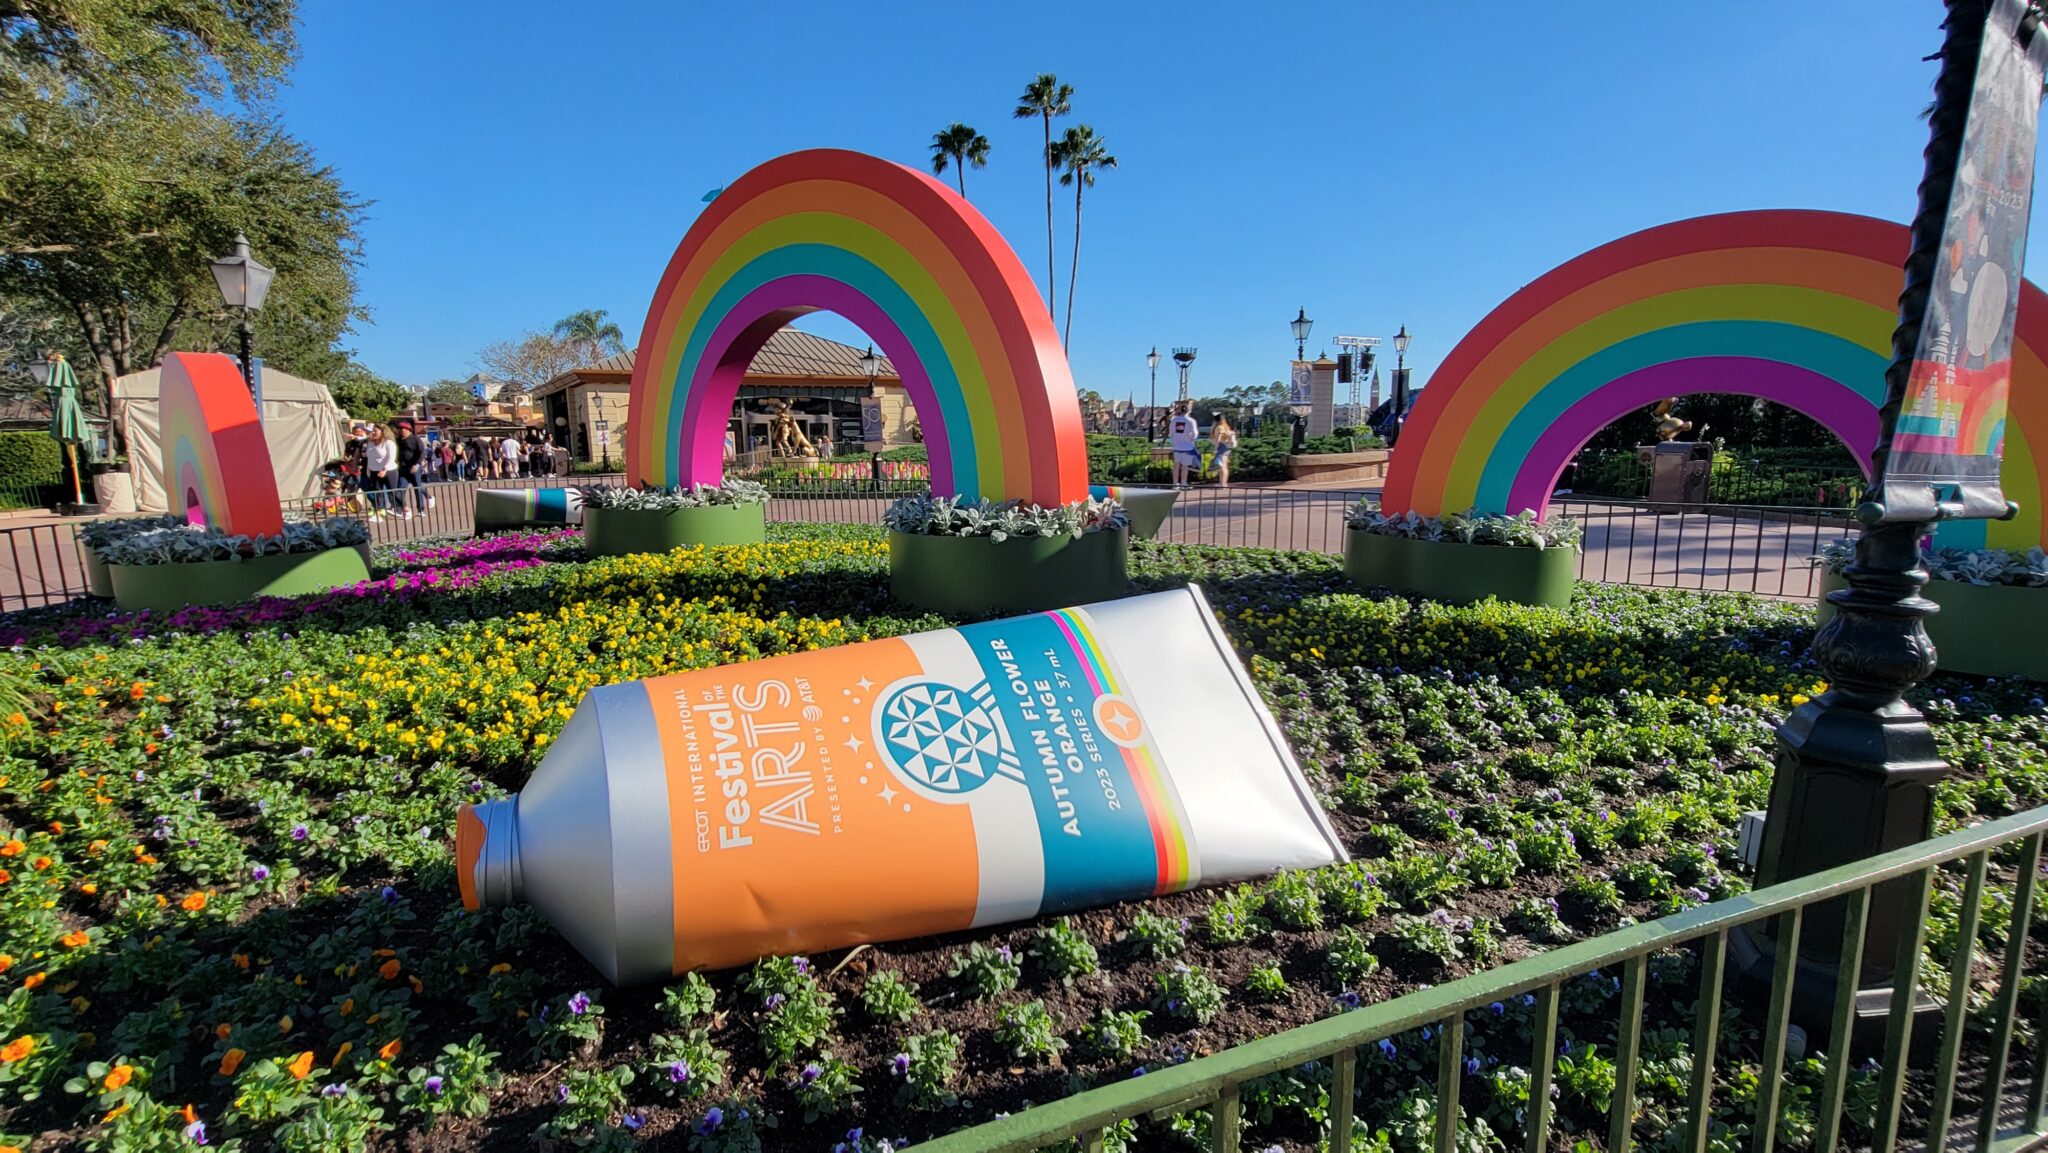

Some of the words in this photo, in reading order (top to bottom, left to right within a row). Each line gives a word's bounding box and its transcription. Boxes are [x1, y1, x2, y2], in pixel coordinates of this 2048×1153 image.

[990, 638, 1040, 721] FLOWER
[1044, 648, 1061, 668] mL
[1054, 671, 1071, 689] 37
[702, 690, 714, 701] OF
[713, 684, 726, 700] THE
[794, 677, 816, 703] AT&T
[673, 688, 706, 802] INTERNATIONAL
[813, 727, 825, 741] BY
[1034, 679, 1084, 774] ORANGE
[1071, 708, 1103, 763] SERIES
[693, 703, 753, 849] Festival
[732, 679, 821, 835] ARTS
[819, 747, 843, 833] PRESENTED
[1031, 729, 1082, 837] AUTUMN
[1096, 767, 1122, 811] 2023
[695, 809, 711, 852] EPCOT
